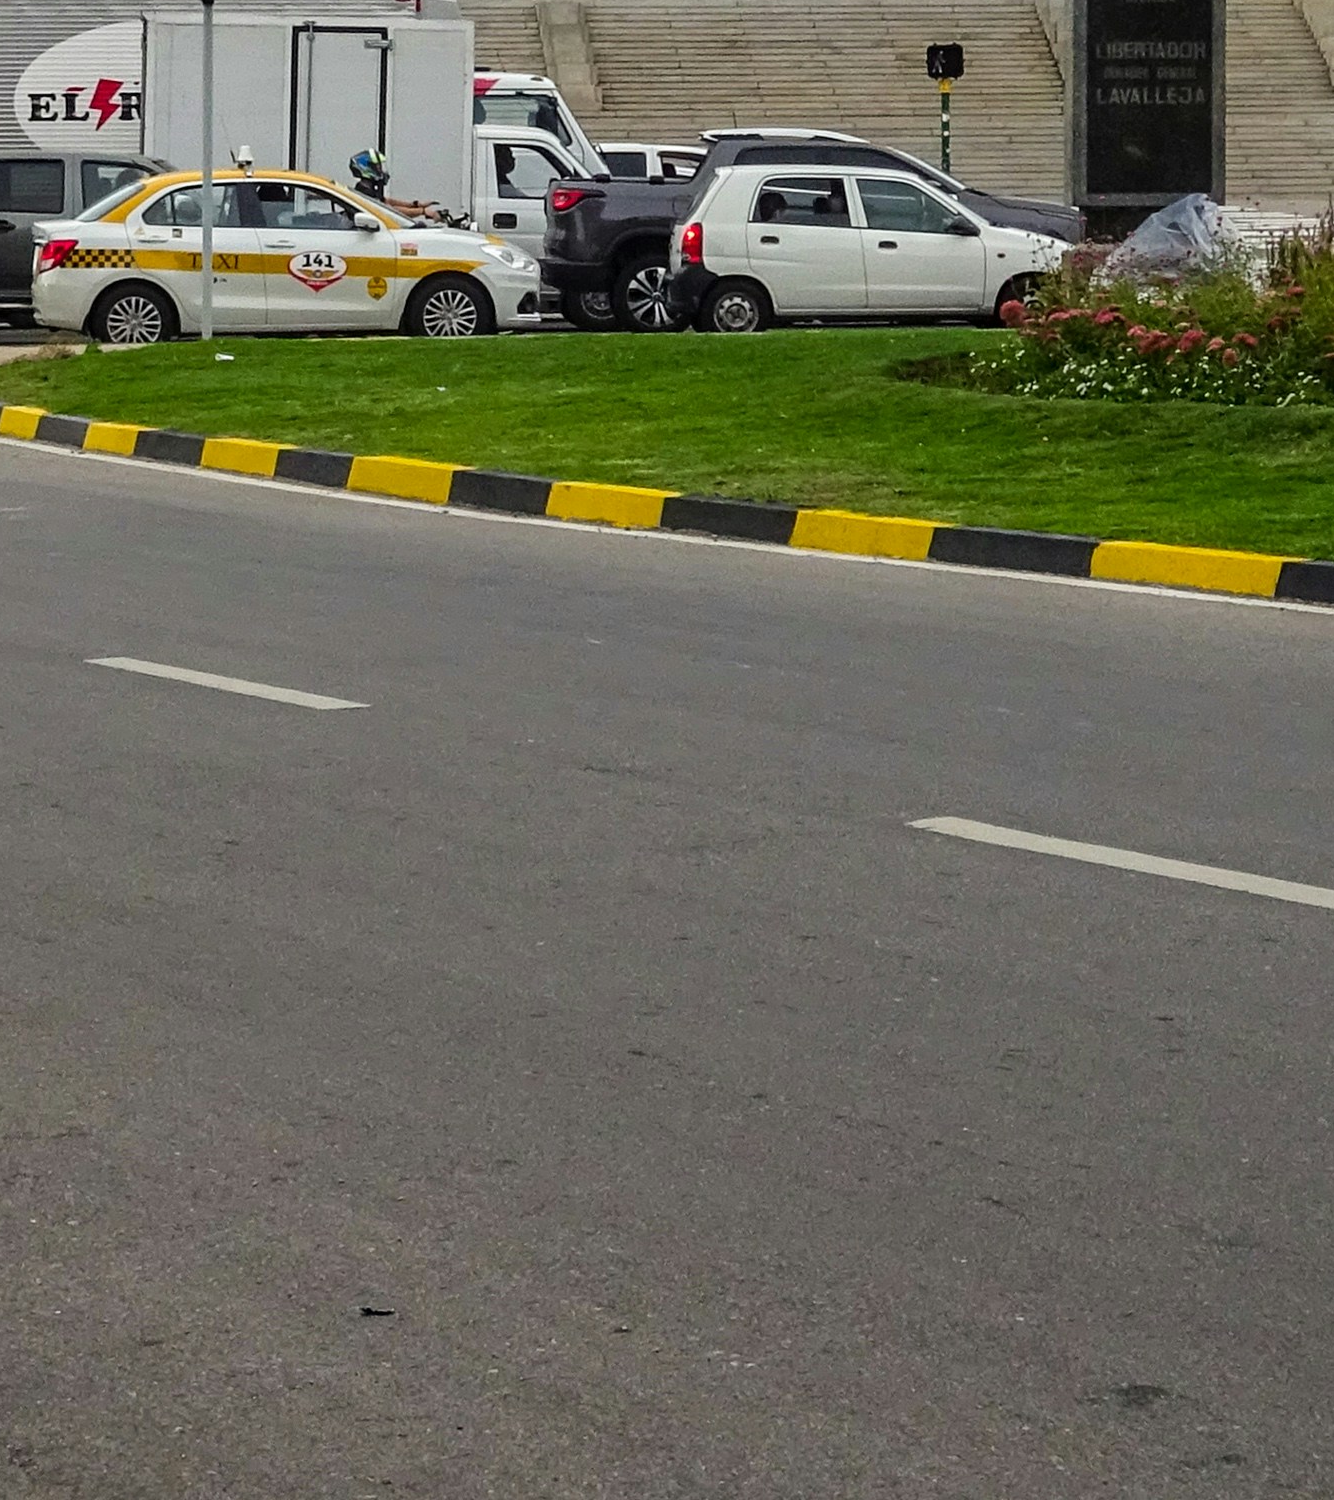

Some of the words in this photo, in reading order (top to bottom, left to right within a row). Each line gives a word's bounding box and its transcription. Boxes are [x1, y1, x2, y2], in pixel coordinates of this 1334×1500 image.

[1096, 41, 1206, 59] LIBERTADOR
[1096, 86, 1206, 105] LAVALLEJA
[187, 252, 239, 269] TXI
[302, 254, 334, 268] 141
